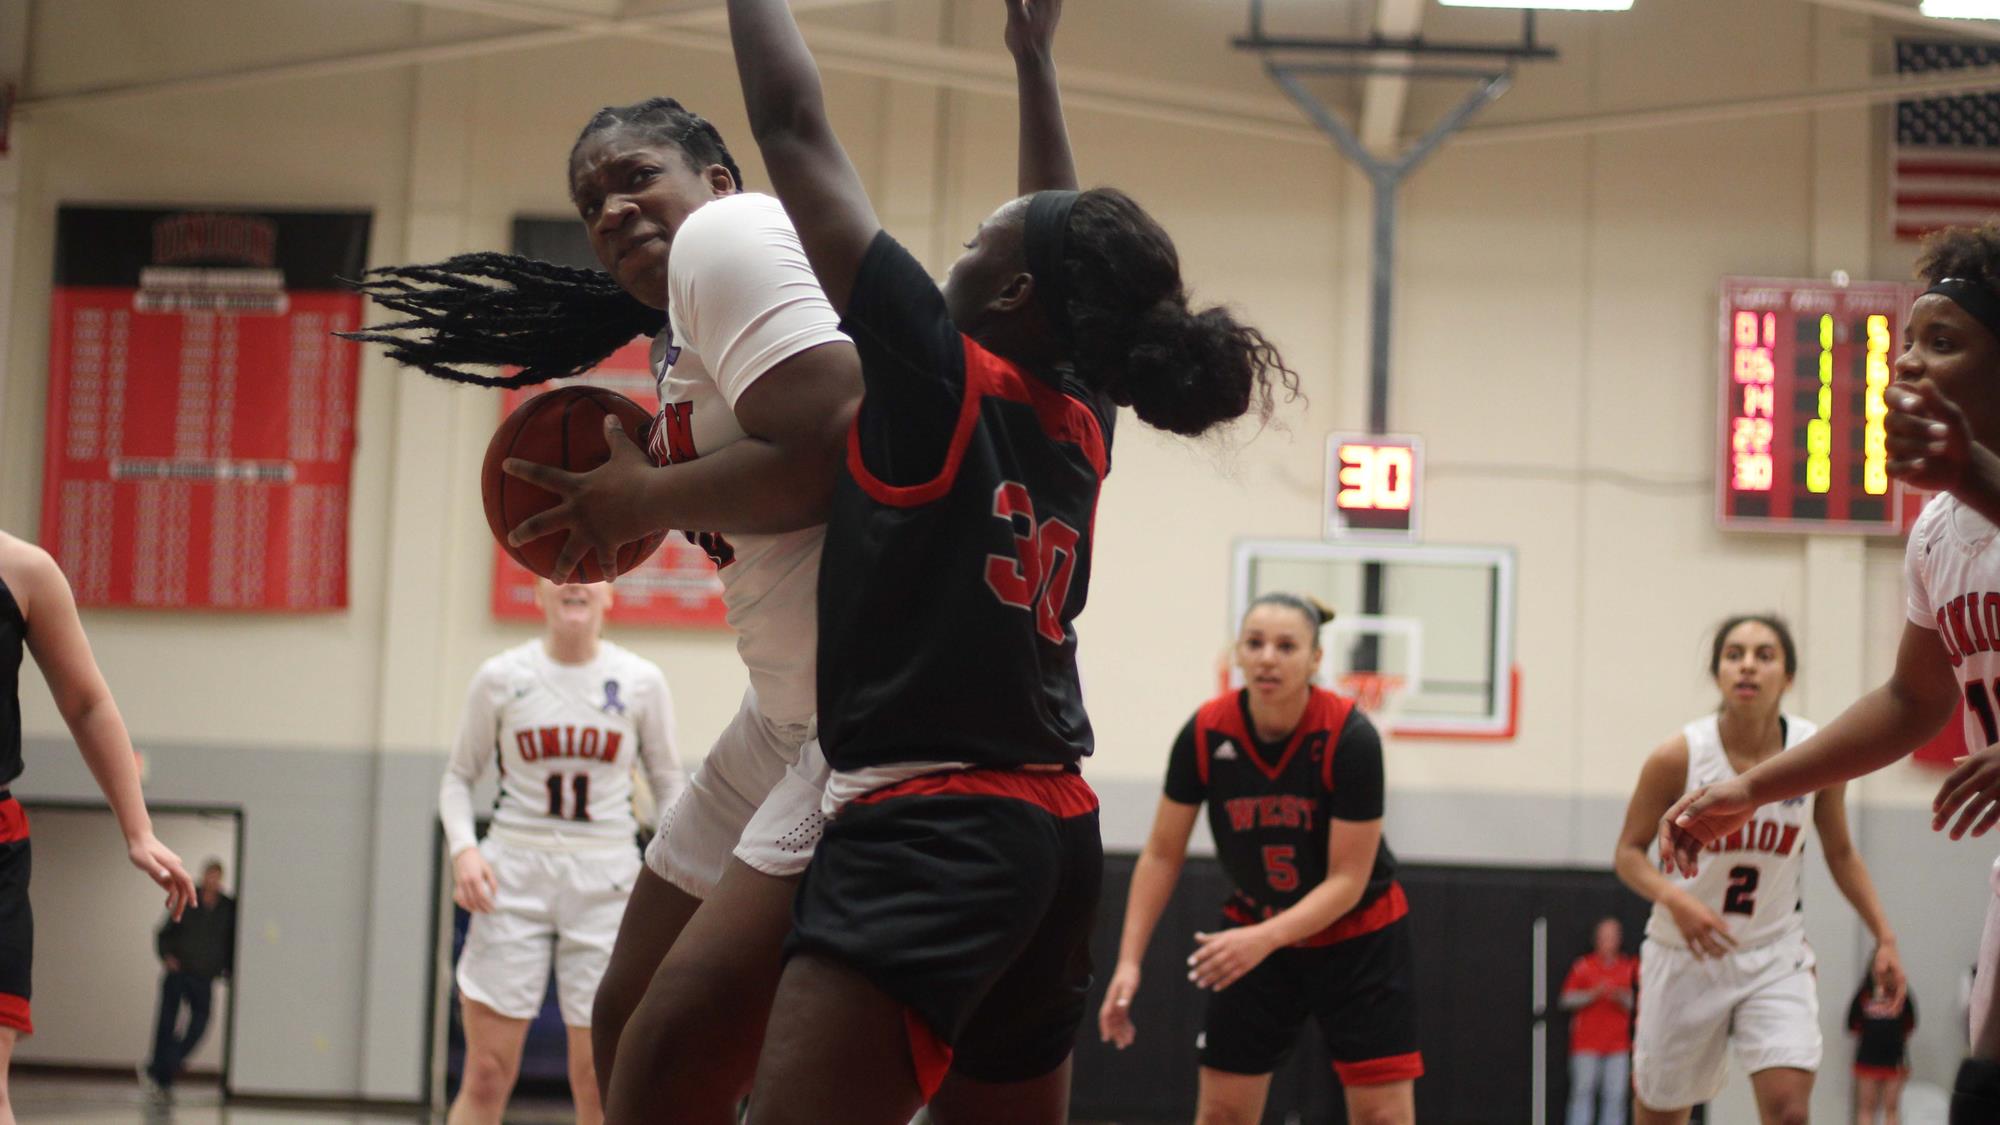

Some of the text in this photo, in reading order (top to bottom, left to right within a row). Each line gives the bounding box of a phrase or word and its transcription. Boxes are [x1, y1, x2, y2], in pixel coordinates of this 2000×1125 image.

[1337, 444, 1411, 509] 30
[984, 479, 1080, 645] 30
[515, 726, 623, 763] UNION
[546, 772, 593, 822] 11
[1226, 795, 1316, 831] WEST
[1263, 846, 1298, 891] 5
[1722, 865, 1761, 916] 2
